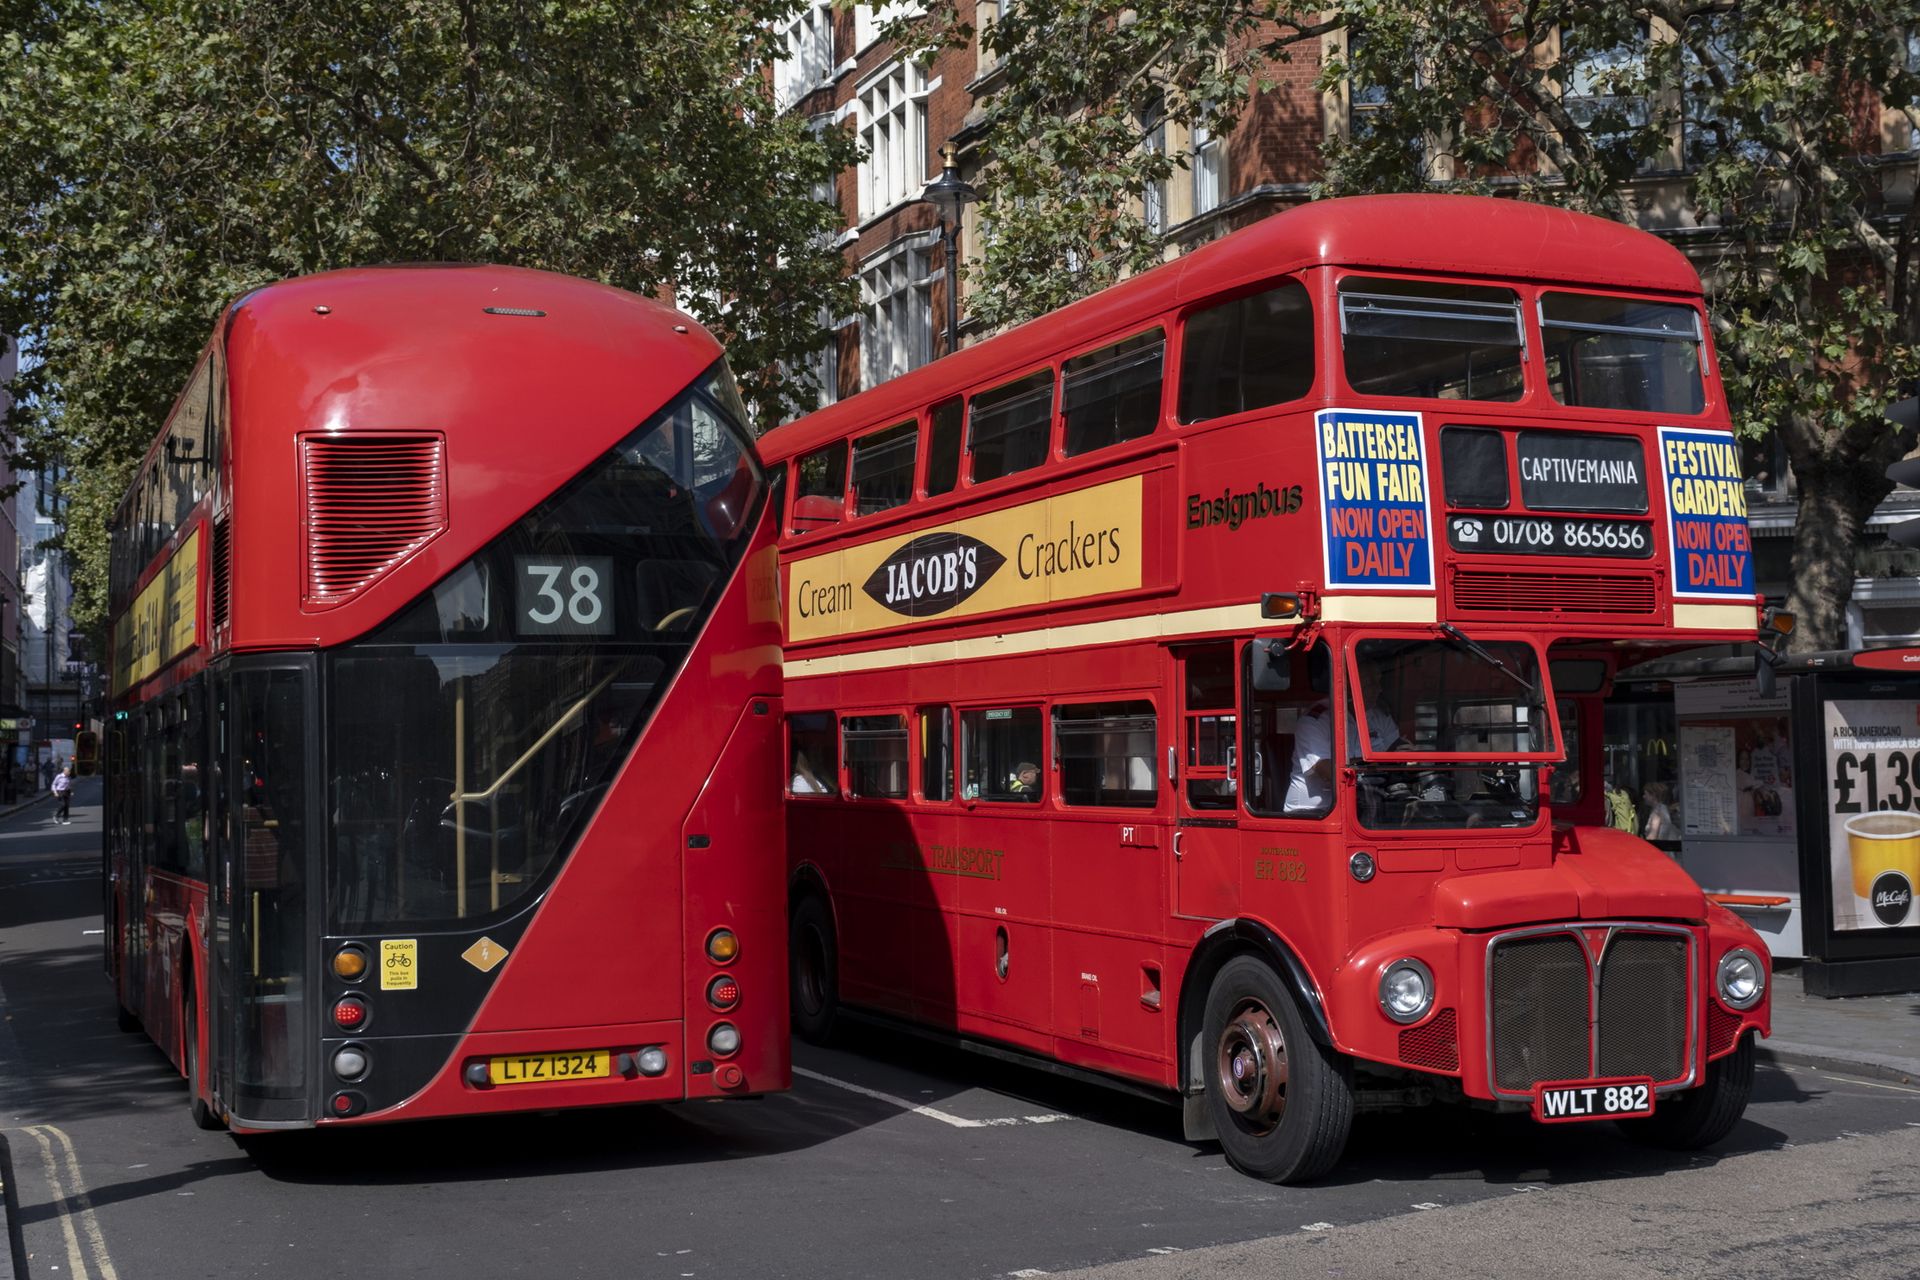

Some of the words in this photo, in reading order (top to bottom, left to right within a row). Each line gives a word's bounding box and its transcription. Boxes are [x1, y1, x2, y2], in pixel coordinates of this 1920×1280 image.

[1322, 422, 1420, 461] BATTERSEA
[1326, 461, 1371, 501] FUN
[1376, 463, 1423, 502] FAIR
[1521, 457, 1639, 485] CAPTIVEMANIA
[1186, 482, 1304, 532] Ensignbus
[1671, 477, 1748, 518] GARDENS
[1330, 507, 1373, 538] NOW
[1377, 508, 1425, 539] OPEN
[1493, 519, 1555, 546] 01708
[1563, 521, 1645, 549] 865656
[1675, 520, 1711, 550] NOW
[1714, 522, 1752, 553] OPEN
[1017, 520, 1121, 580] Crackers
[1345, 541, 1415, 577] DAILY
[885, 545, 978, 604] JACOB'S
[1688, 552, 1746, 587] DAILY
[527, 565, 602, 625] 38
[798, 580, 853, 618] Cream
[1833, 726, 1839, 738] A
[1840, 726, 1857, 737] RICH
[1859, 725, 1902, 737] AMERICANO
[1122, 826, 1134, 843] PT
[930, 845, 1005, 881] TRANSPORT
[1254, 859, 1274, 881] ER
[1278, 861, 1308, 883] 882
[384, 943, 414, 951] Caution
[504, 1058, 545, 1080] LTZ
[551, 1054, 597, 1076] 1324
[1544, 1089, 1597, 1116] WLT
[1604, 1085, 1649, 1112] 882
